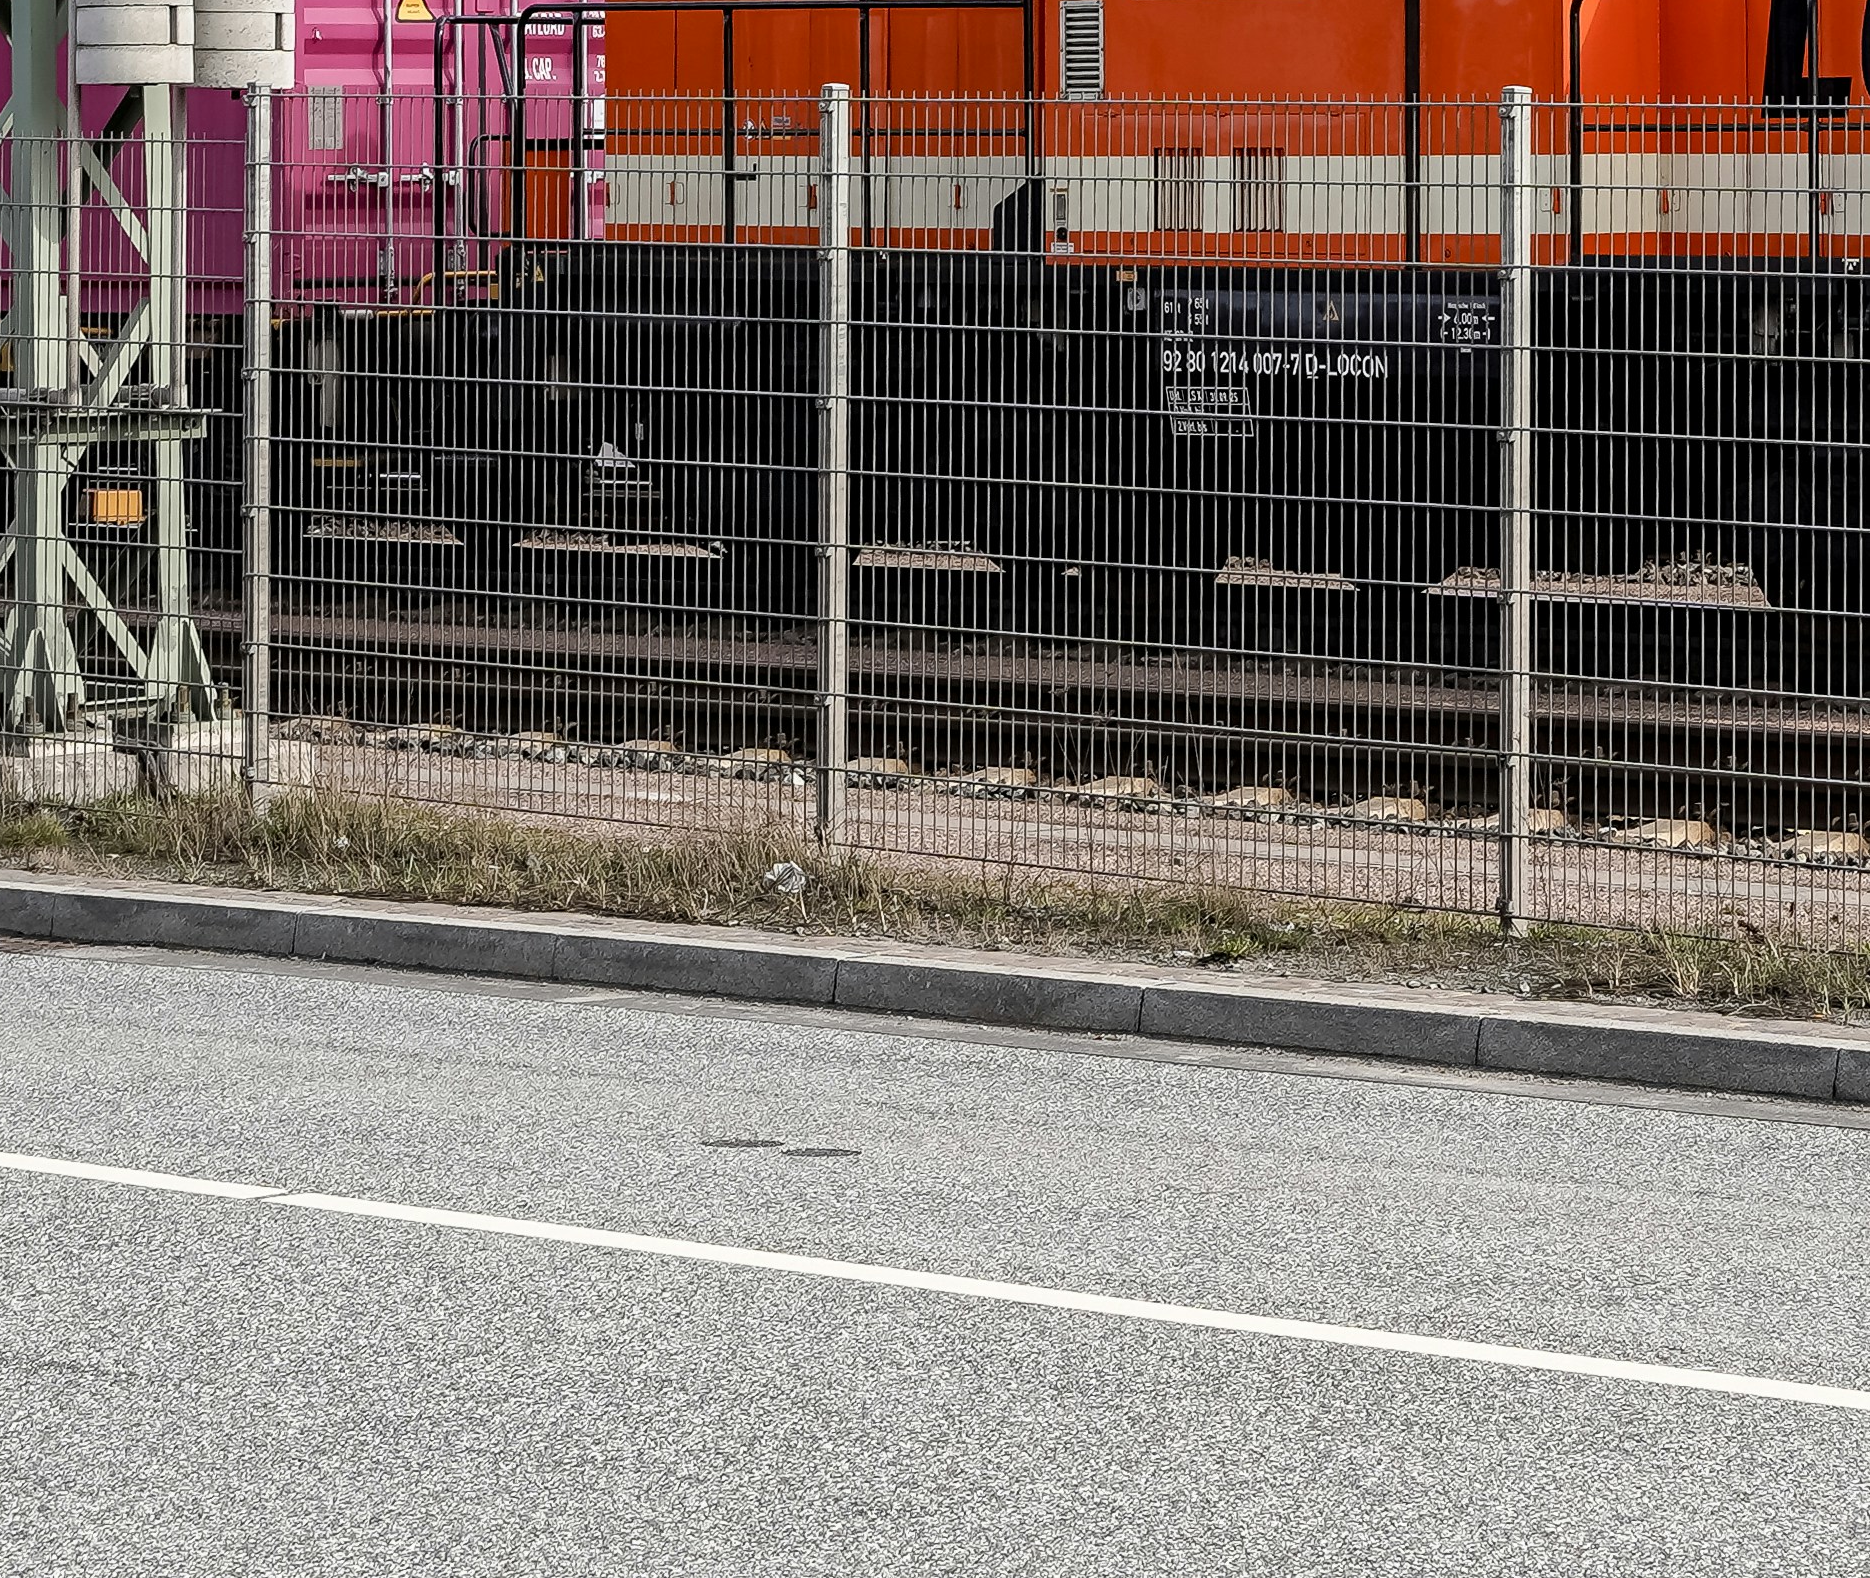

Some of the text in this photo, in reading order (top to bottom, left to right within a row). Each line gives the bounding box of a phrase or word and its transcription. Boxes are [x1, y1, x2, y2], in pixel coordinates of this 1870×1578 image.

[1163, 350, 1182, 372] 92
[1187, 350, 1205, 373] 80
[1211, 351, 1249, 374] 1214
[1253, 352, 1299, 376] 007-7
